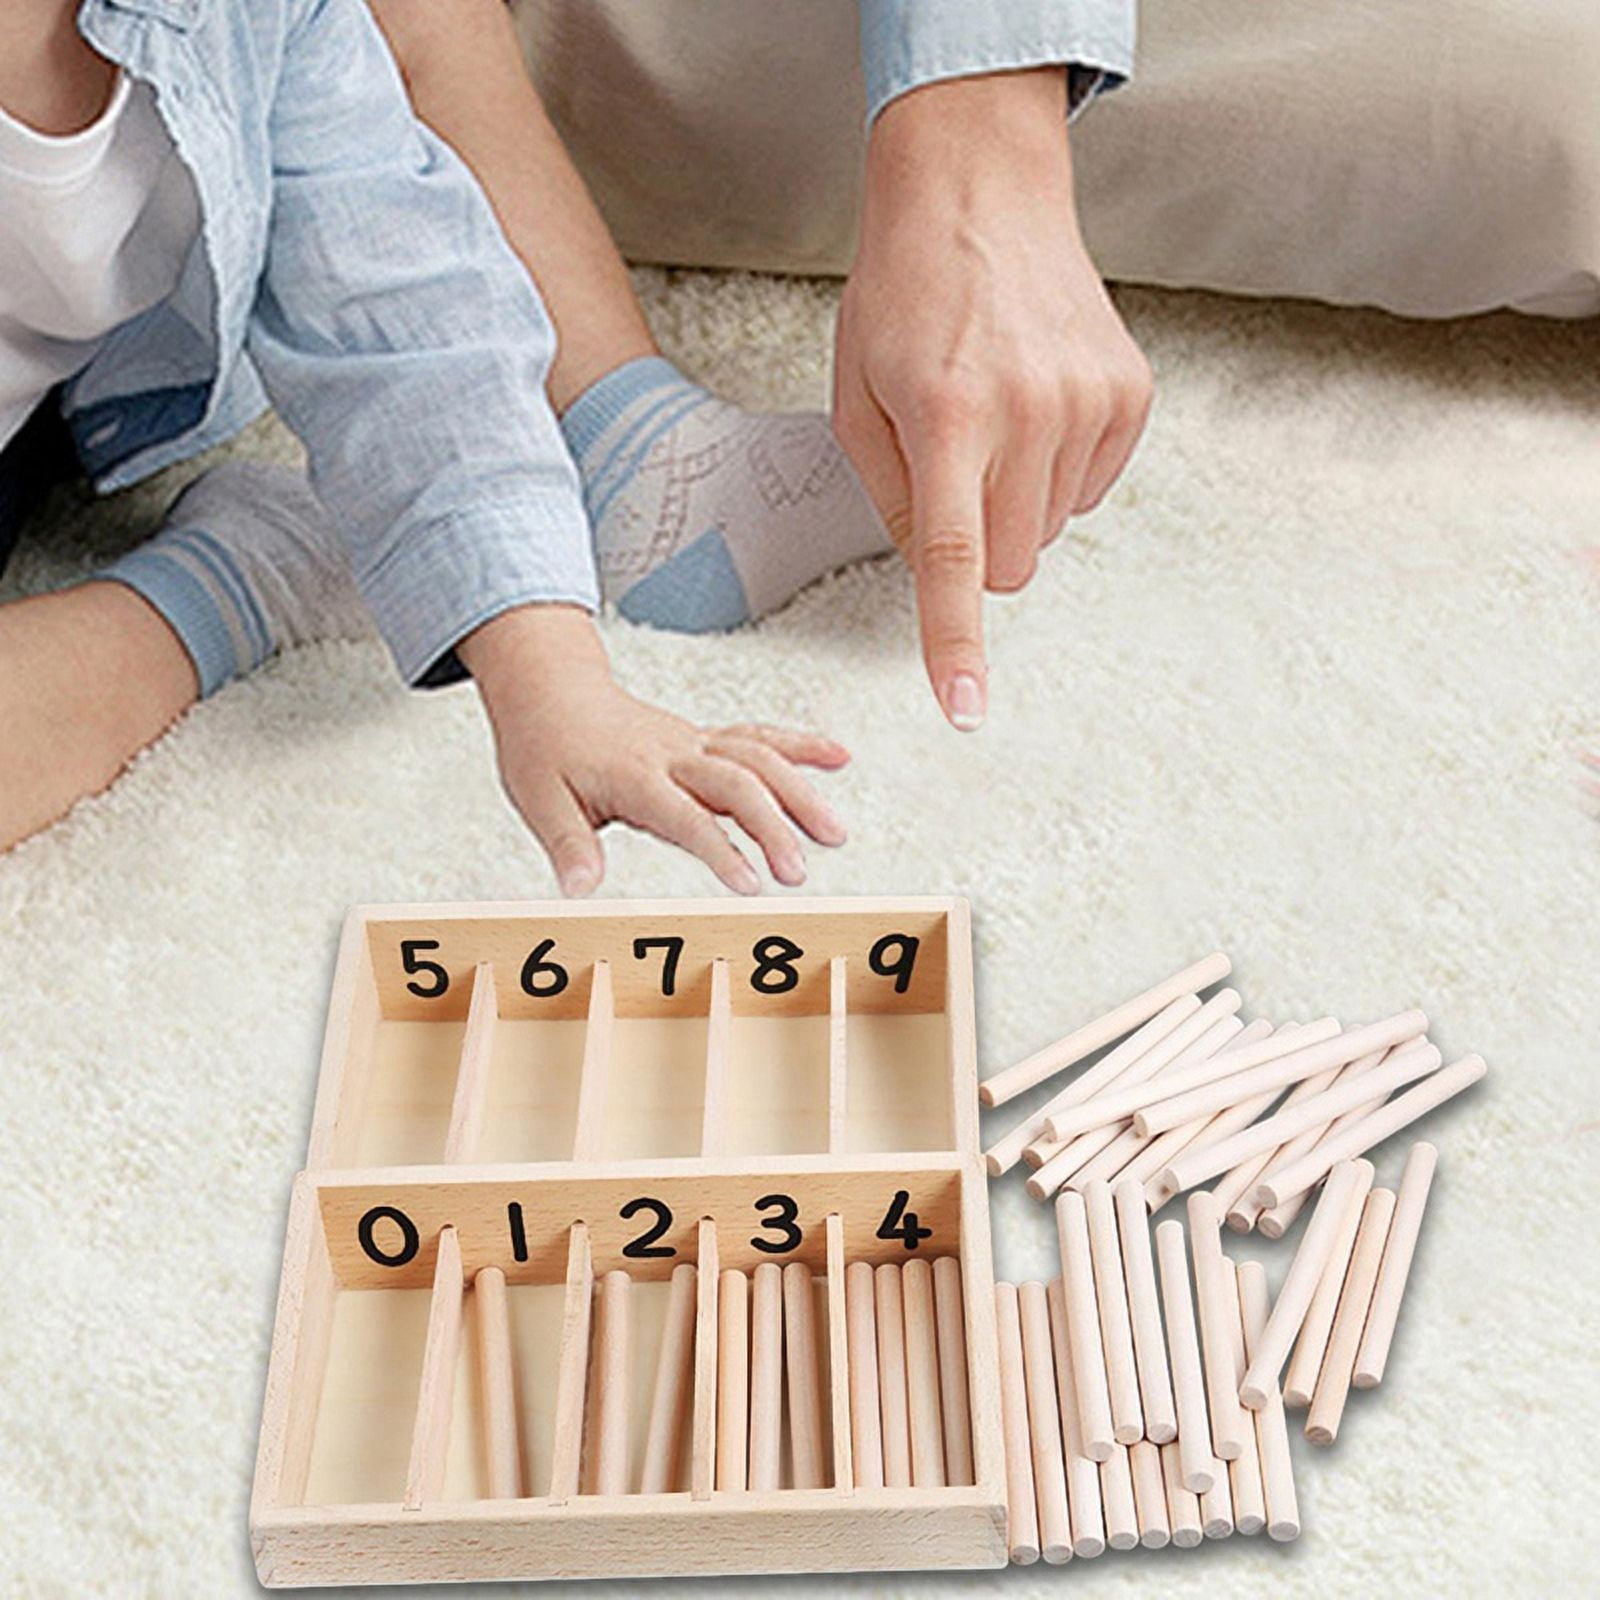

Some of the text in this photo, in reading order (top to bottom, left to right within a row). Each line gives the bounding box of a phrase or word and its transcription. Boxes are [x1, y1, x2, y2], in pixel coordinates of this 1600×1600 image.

[400, 933, 920, 999] 5 6 7 8 9
[357, 1190, 933, 1268] 0 1 2 3 4
